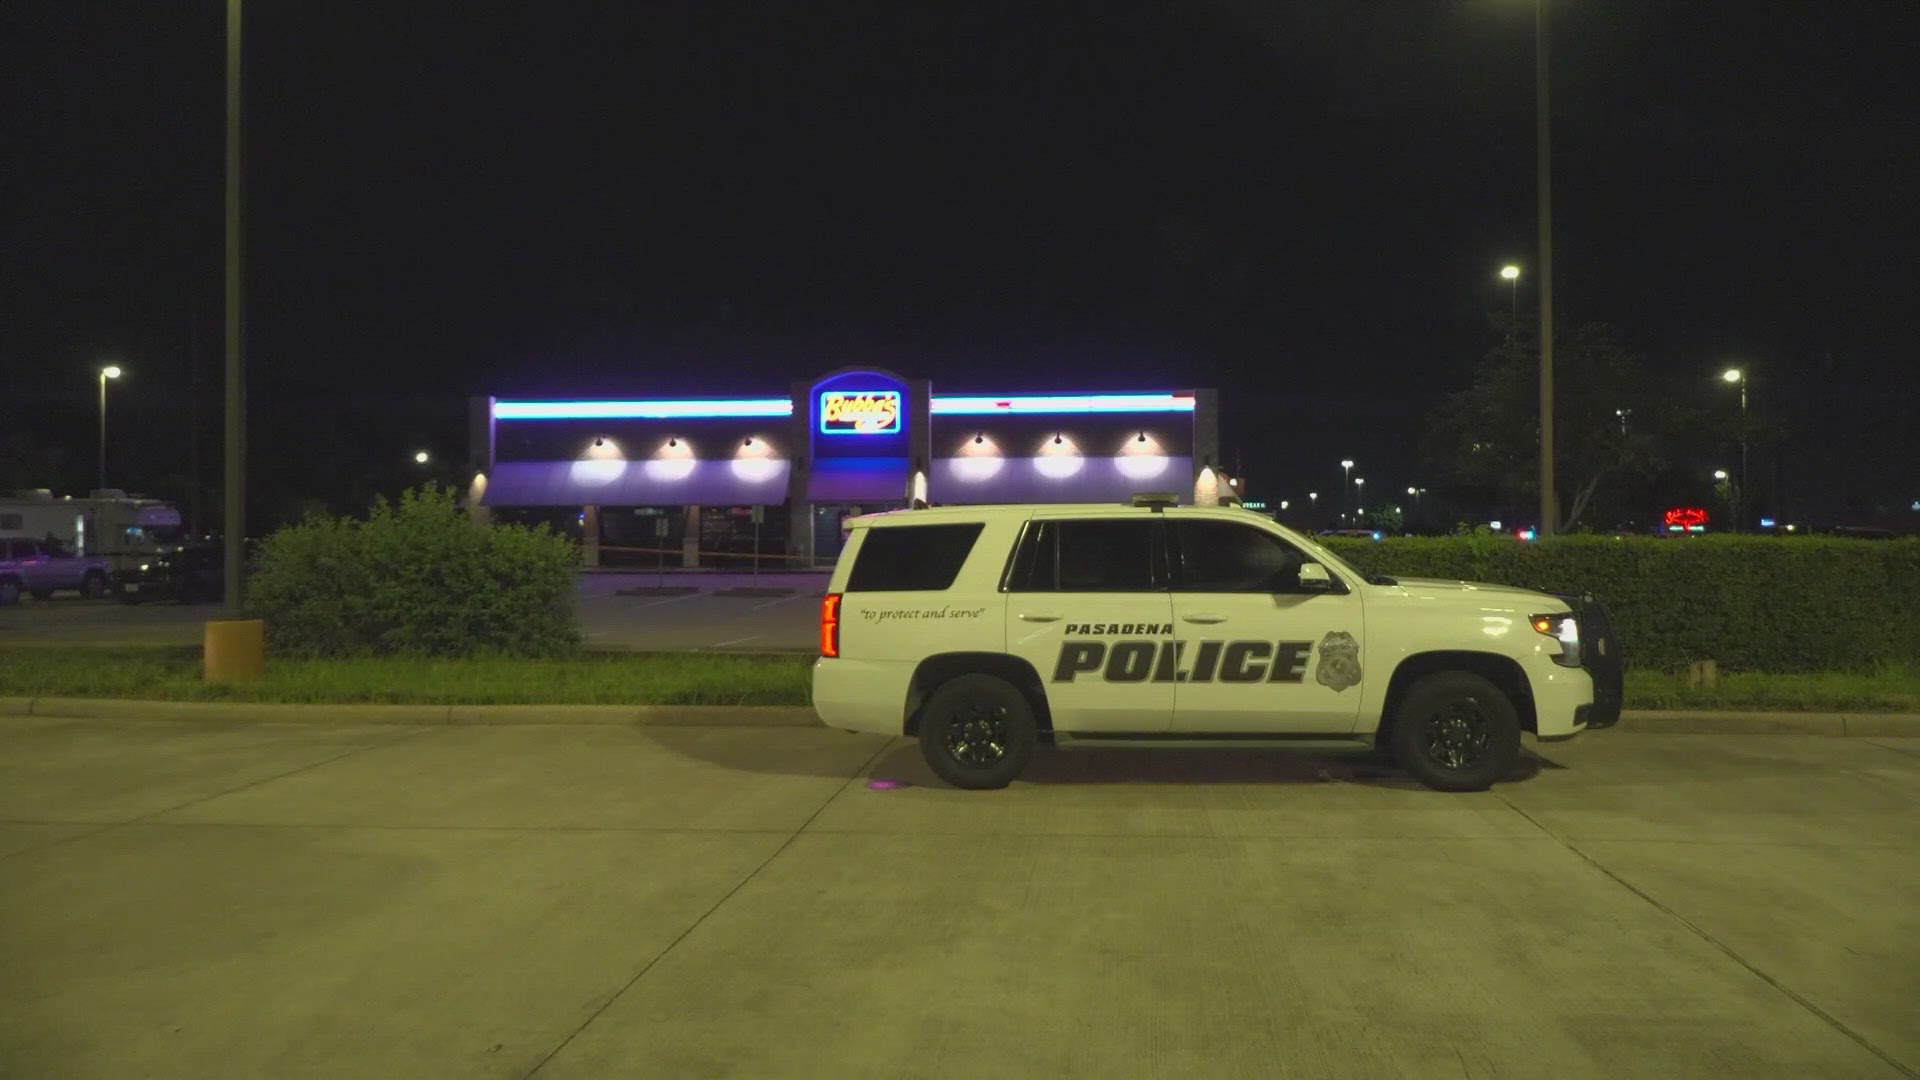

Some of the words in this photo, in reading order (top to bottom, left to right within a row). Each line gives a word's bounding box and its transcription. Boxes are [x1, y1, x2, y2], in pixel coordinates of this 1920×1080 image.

[875, 608, 920, 624] protect
[922, 605, 950, 618] and
[1064, 623, 1173, 635] PASADENA
[1051, 640, 1314, 683] POLICE
